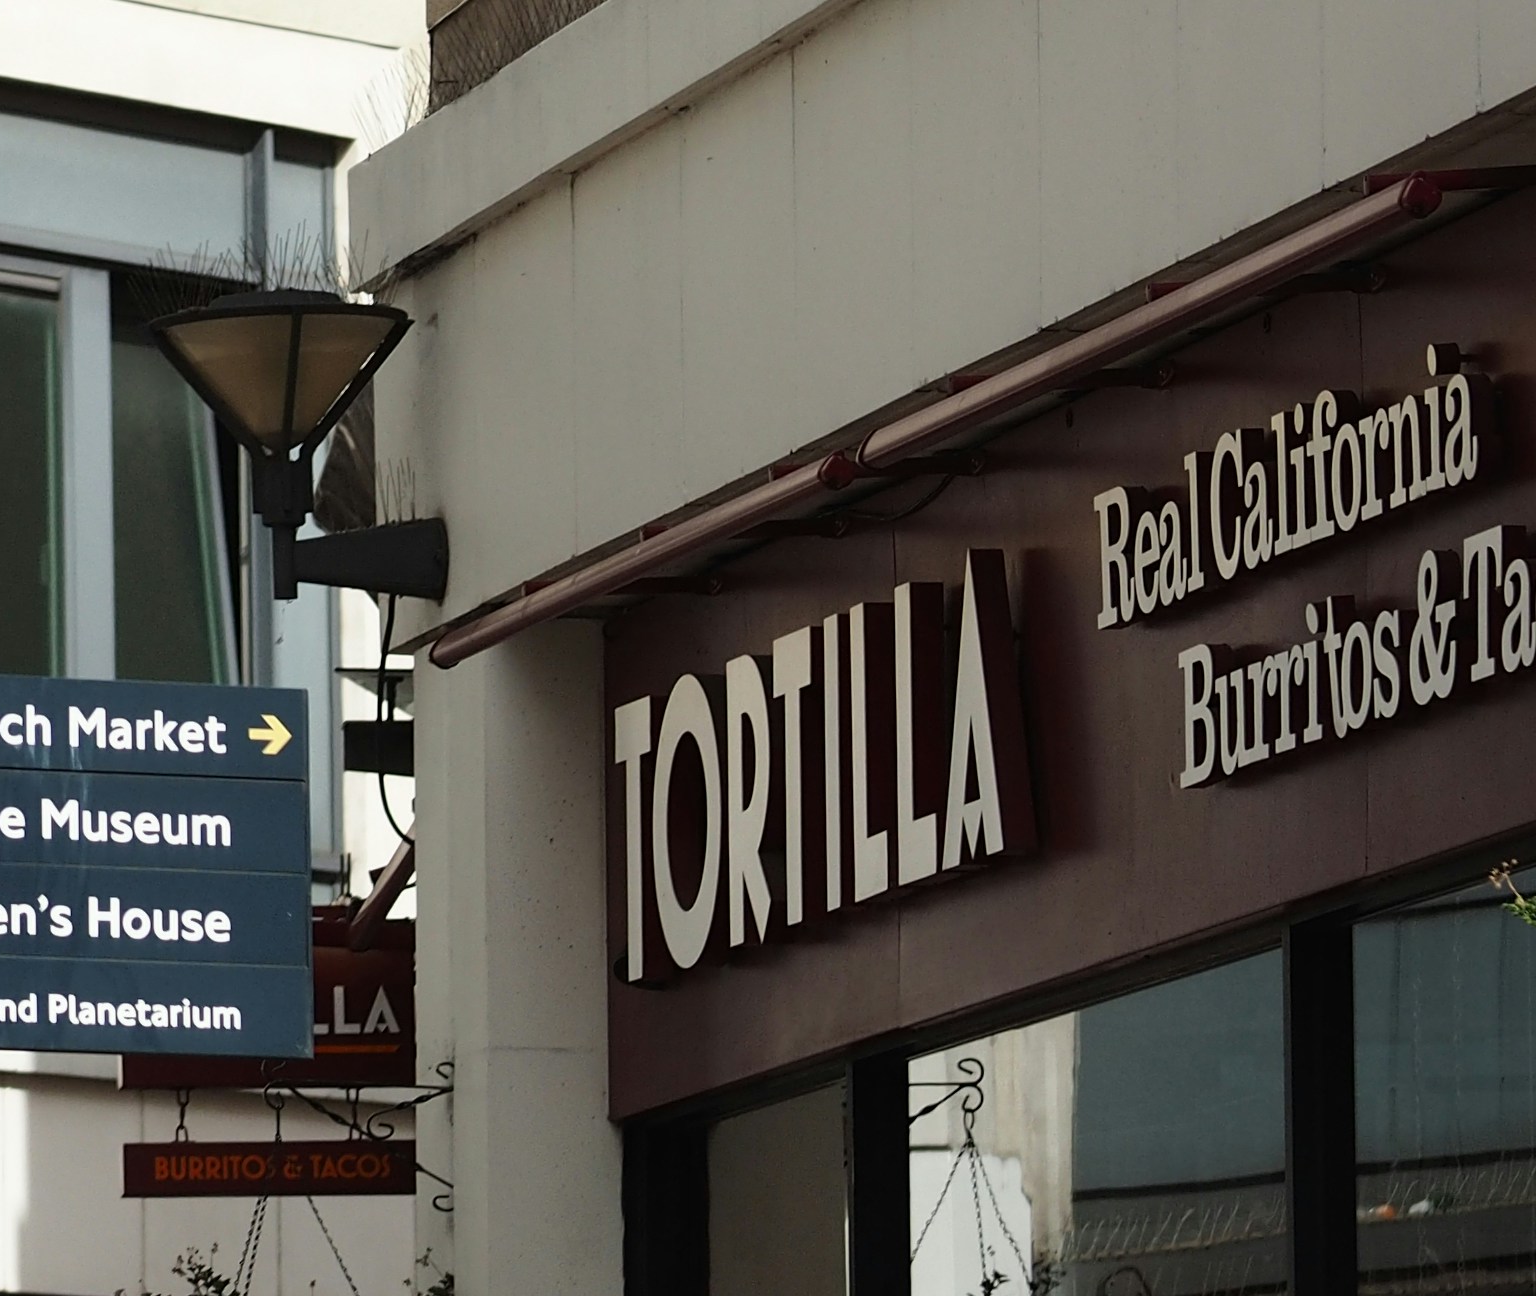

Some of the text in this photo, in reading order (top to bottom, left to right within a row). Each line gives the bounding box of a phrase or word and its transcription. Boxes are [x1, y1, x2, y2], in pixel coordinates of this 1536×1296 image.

[1093, 343, 1478, 630] Real California
[1178, 595, 1401, 789] Burritos
[1409, 549, 1456, 705] &
[68, 705, 227, 754] Market
[614, 547, 1004, 982] TORTILLA
[41, 798, 231, 847] Museum
[88, 895, 232, 943] House
[48, 993, 242, 1030] Planetarium
[154, 1153, 278, 1181] BURRITOS
[309, 1153, 392, 1179] TACOS
